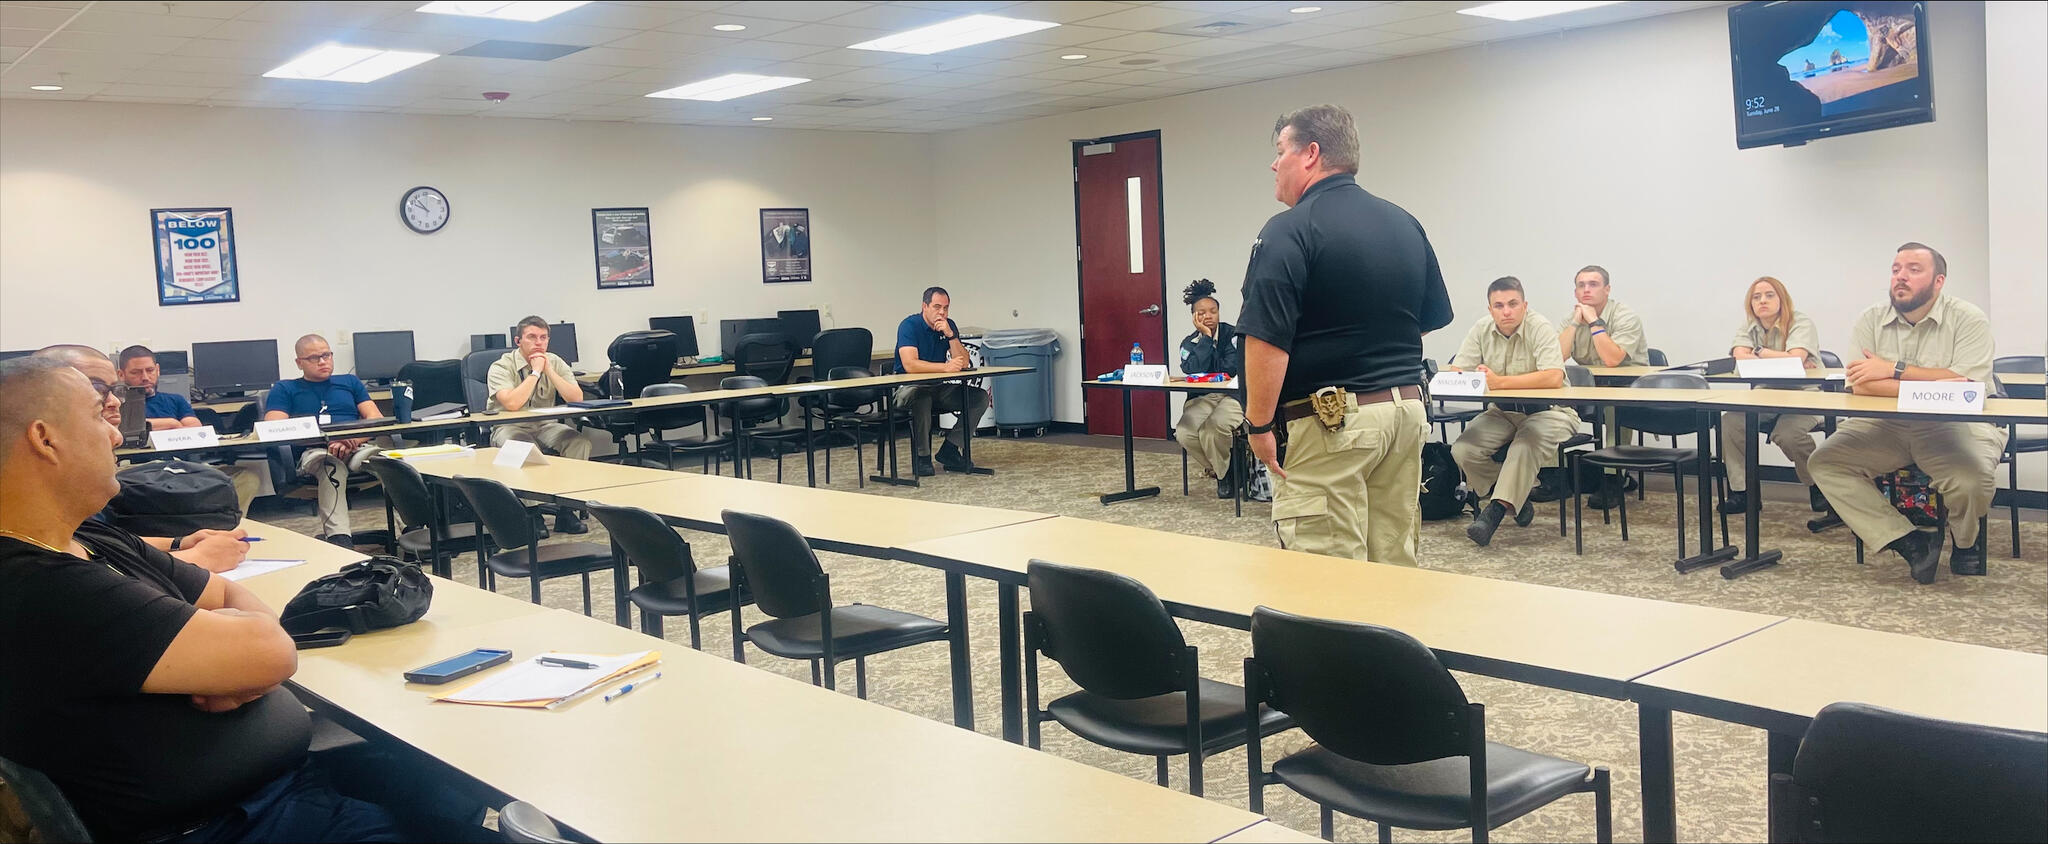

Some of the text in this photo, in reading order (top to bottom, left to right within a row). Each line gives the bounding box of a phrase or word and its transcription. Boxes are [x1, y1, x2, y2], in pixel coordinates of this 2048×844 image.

[1745, 96, 1765, 110] 9:52
[167, 220, 217, 229] BELOW
[173, 238, 216, 249] 100
[1912, 391, 1955, 401] MOORE
